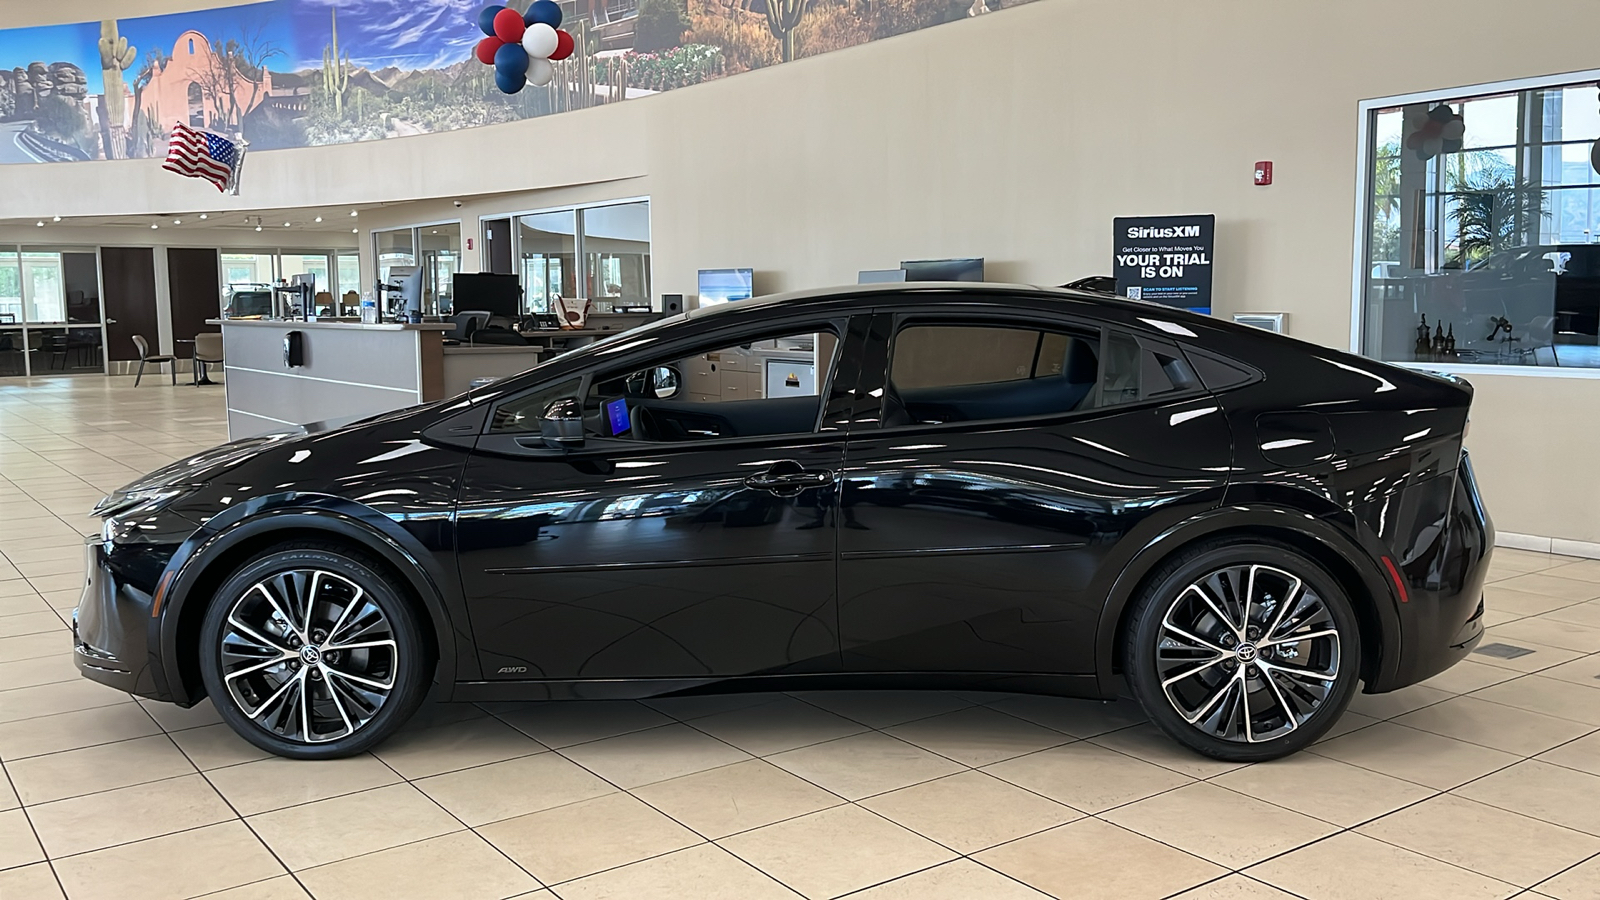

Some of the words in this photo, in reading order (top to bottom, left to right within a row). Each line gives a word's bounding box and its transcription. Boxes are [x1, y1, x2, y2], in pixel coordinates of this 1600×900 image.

[1127, 226, 1200, 239] SiriusXM
[1116, 254, 1160, 267] YOUR
[1163, 253, 1210, 266] TRIAL
[1141, 266, 1156, 278] IS
[1159, 266, 1184, 278] ON
[497, 666, 528, 674] AWD
